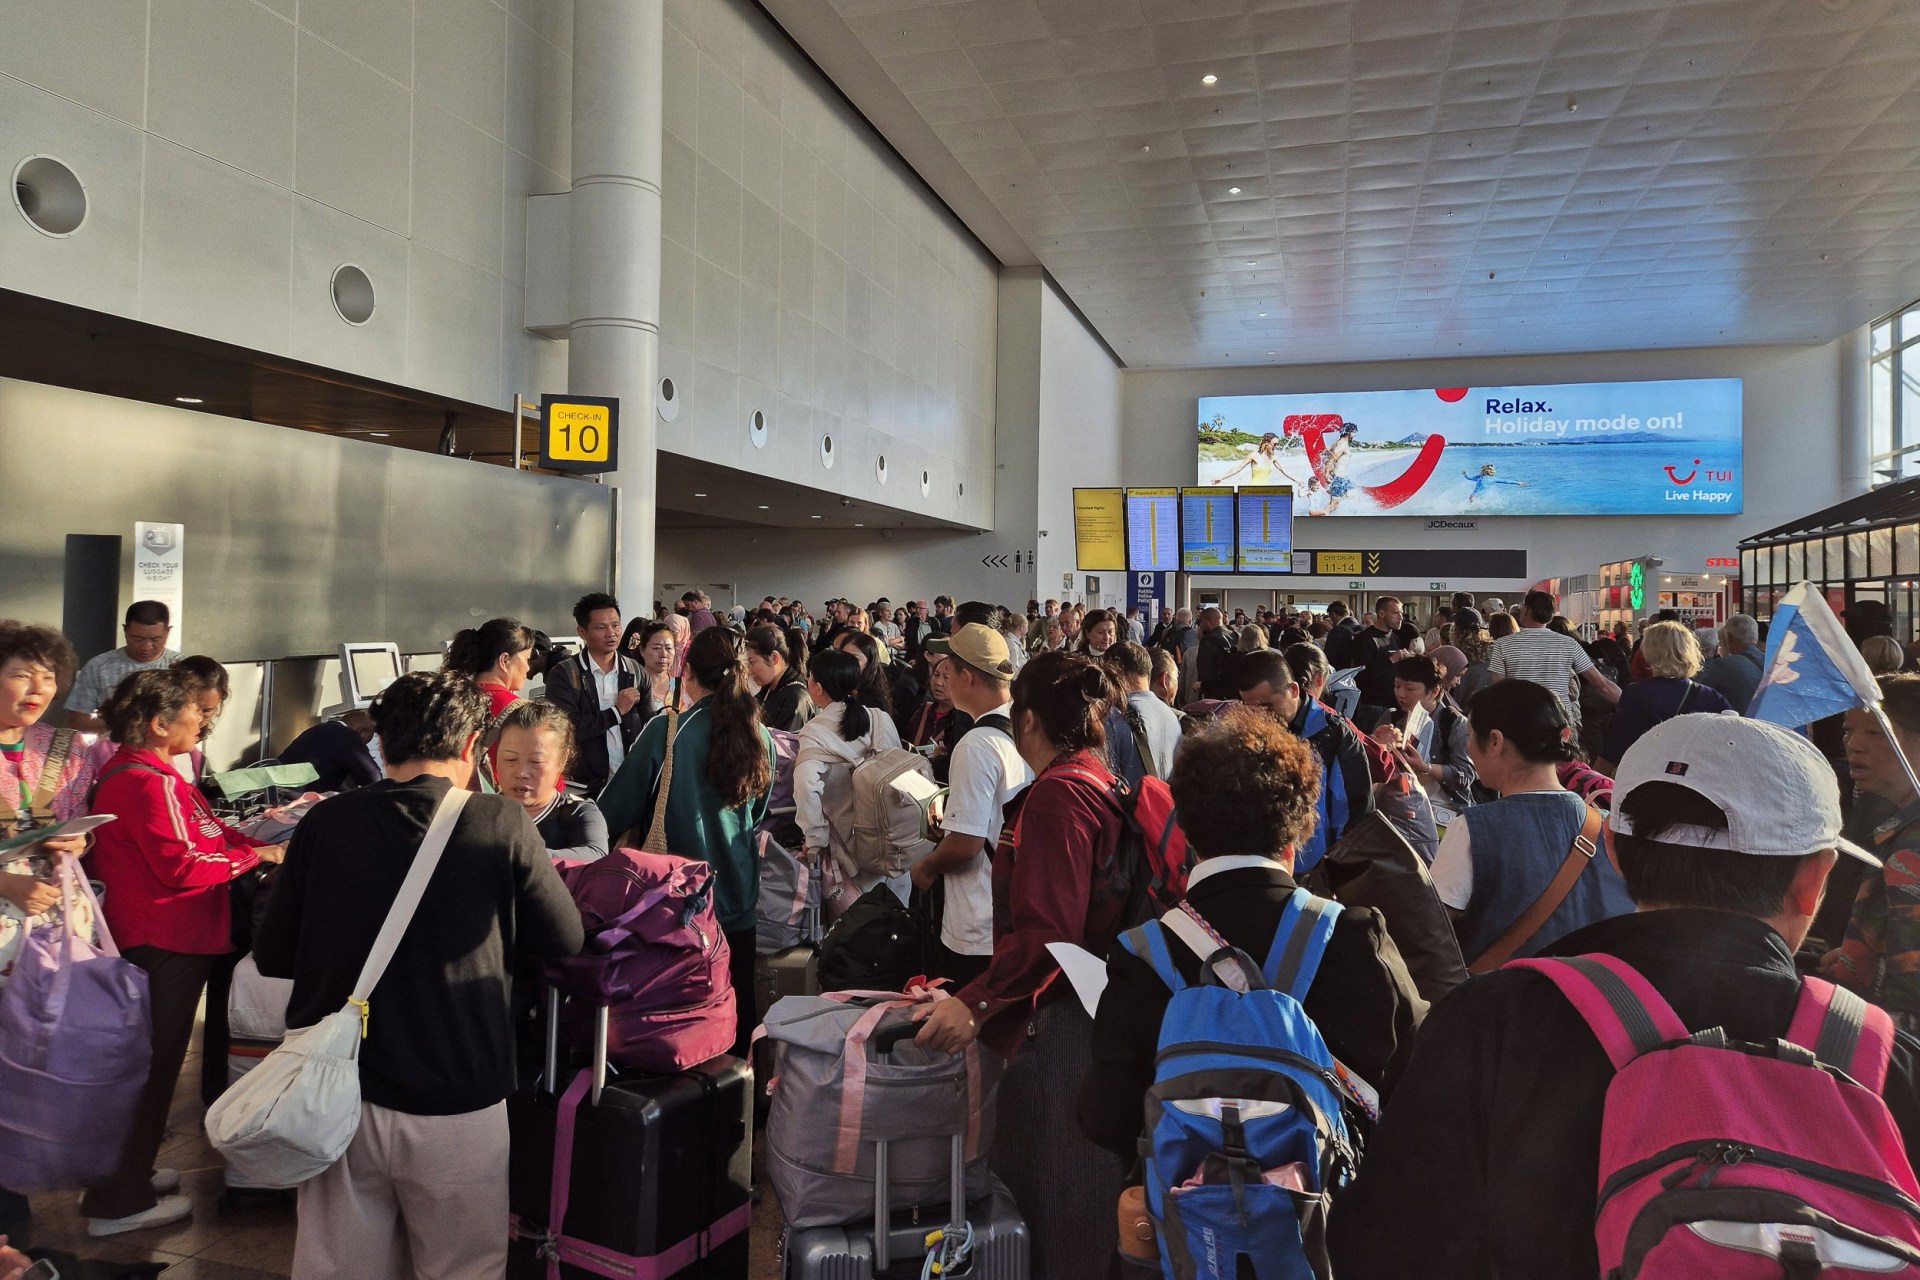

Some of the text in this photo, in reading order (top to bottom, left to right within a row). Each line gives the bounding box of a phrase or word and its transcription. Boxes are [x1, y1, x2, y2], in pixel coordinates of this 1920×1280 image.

[1486, 398, 1552, 414] Relax.
[558, 411, 601, 421] CHECK-IN
[1485, 412, 1683, 436] Holiday mode on!
[559, 424, 599, 453] 10
[1705, 470, 1732, 481] TUI
[1665, 490, 1732, 502] Live Happy
[1428, 520, 1475, 528] JCDecaux
[1324, 563, 1355, 573] 11-14
